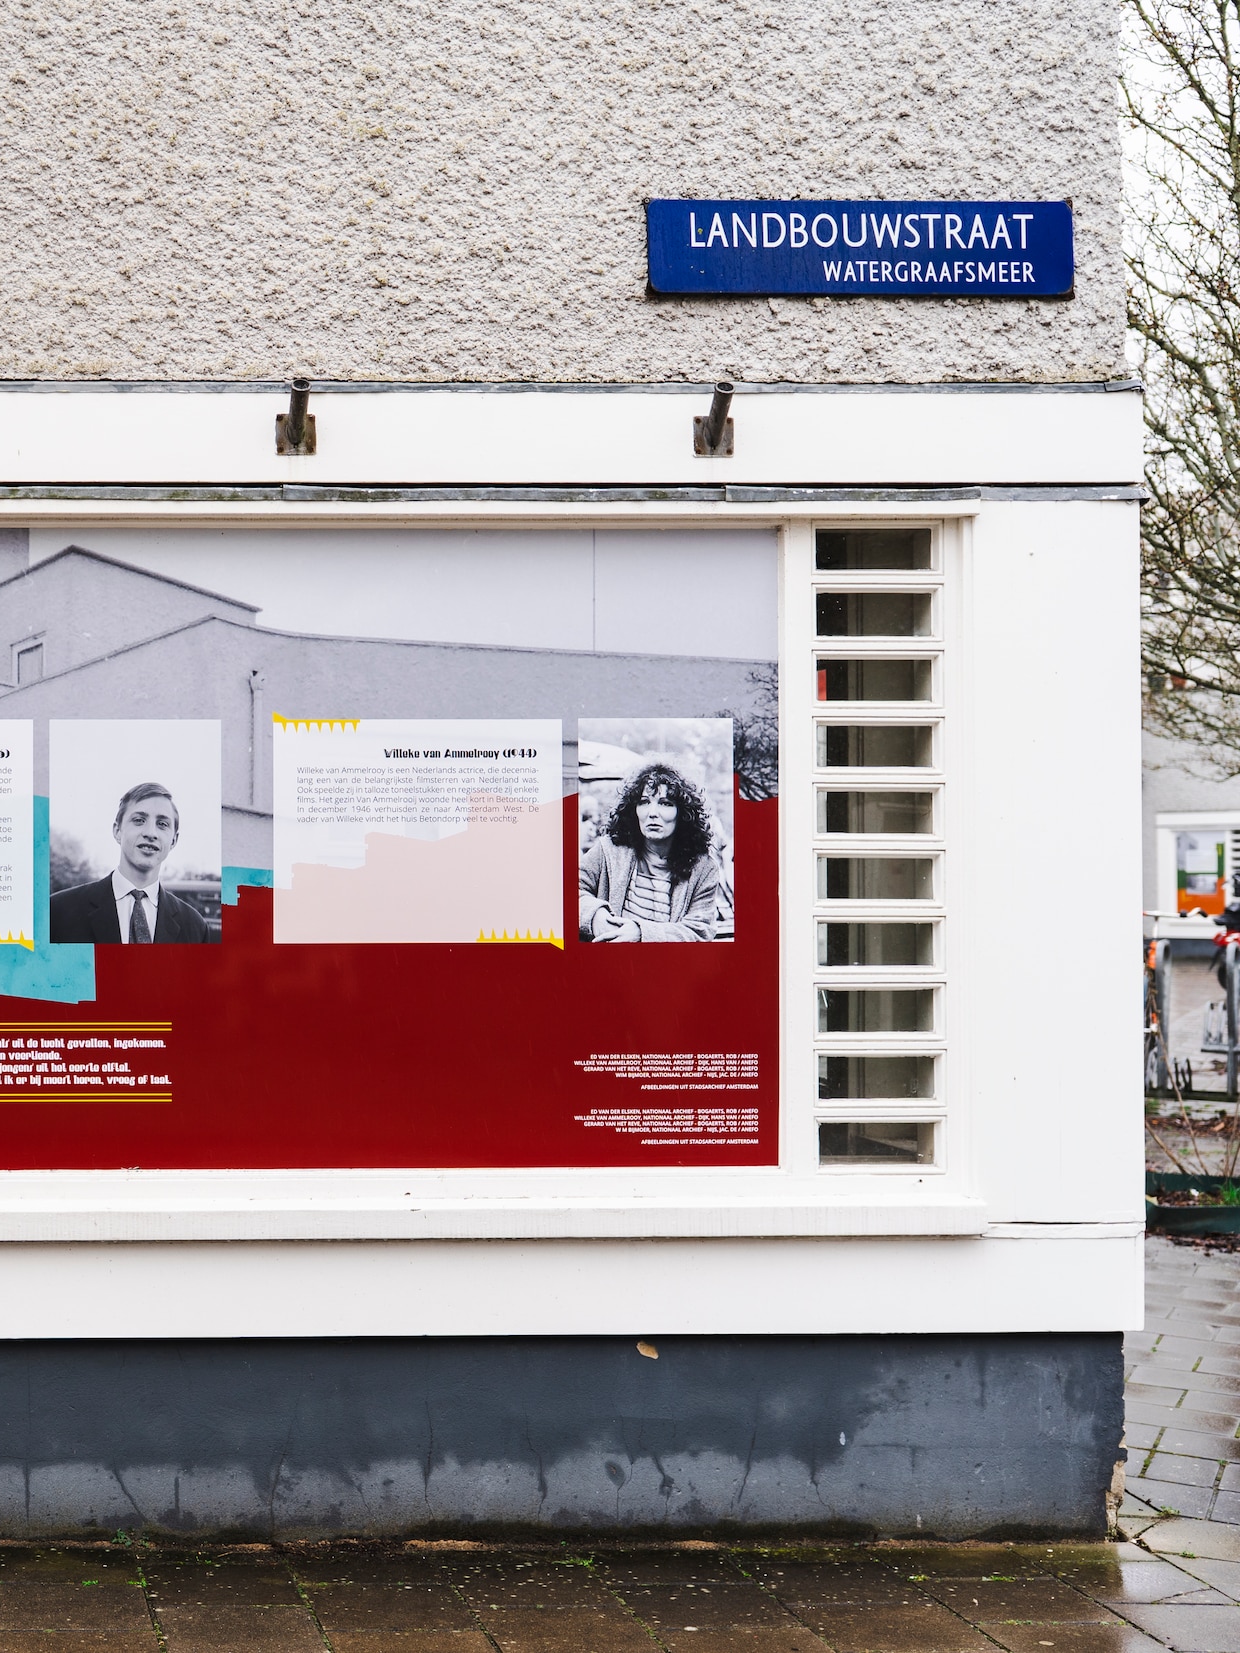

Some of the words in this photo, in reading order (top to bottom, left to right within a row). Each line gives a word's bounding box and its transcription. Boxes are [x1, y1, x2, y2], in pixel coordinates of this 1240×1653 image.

[688, 212, 1035, 250] LANDBOUWSTRAAT
[822, 260, 1036, 283] WATERGRAAFSMEER
[383, 748, 420, 758] Willeke
[444, 748, 500, 760] Ammelrooy
[502, 748, 537, 759] (1944)
[296, 766, 324, 774] Willeke
[341, 766, 386, 776] Ammelrooy
[387, 766, 394, 774] is
[412, 766, 457, 774] Nederlands
[458, 766, 486, 775] actrice,
[487, 766, 500, 774] die
[501, 766, 539, 774] decennia-
[297, 776, 313, 786] lang
[351, 776, 361, 784] de
[365, 776, 413, 786] belangrijkste
[416, 776, 458, 784] filmsterren
[479, 776, 519, 784] Nederland
[296, 785, 313, 793] Ook
[314, 785, 345, 795] speelde
[346, 785, 354, 795] zij
[355, 785, 363, 793] in
[364, 785, 390, 793] talloze
[390, 785, 445, 793] toneelstukken
[458, 785, 503, 795] regisseerde
[504, 785, 513, 795] zij
[513, 785, 540, 793] enkele
[8, 1051, 62, 1060] veertiende.
